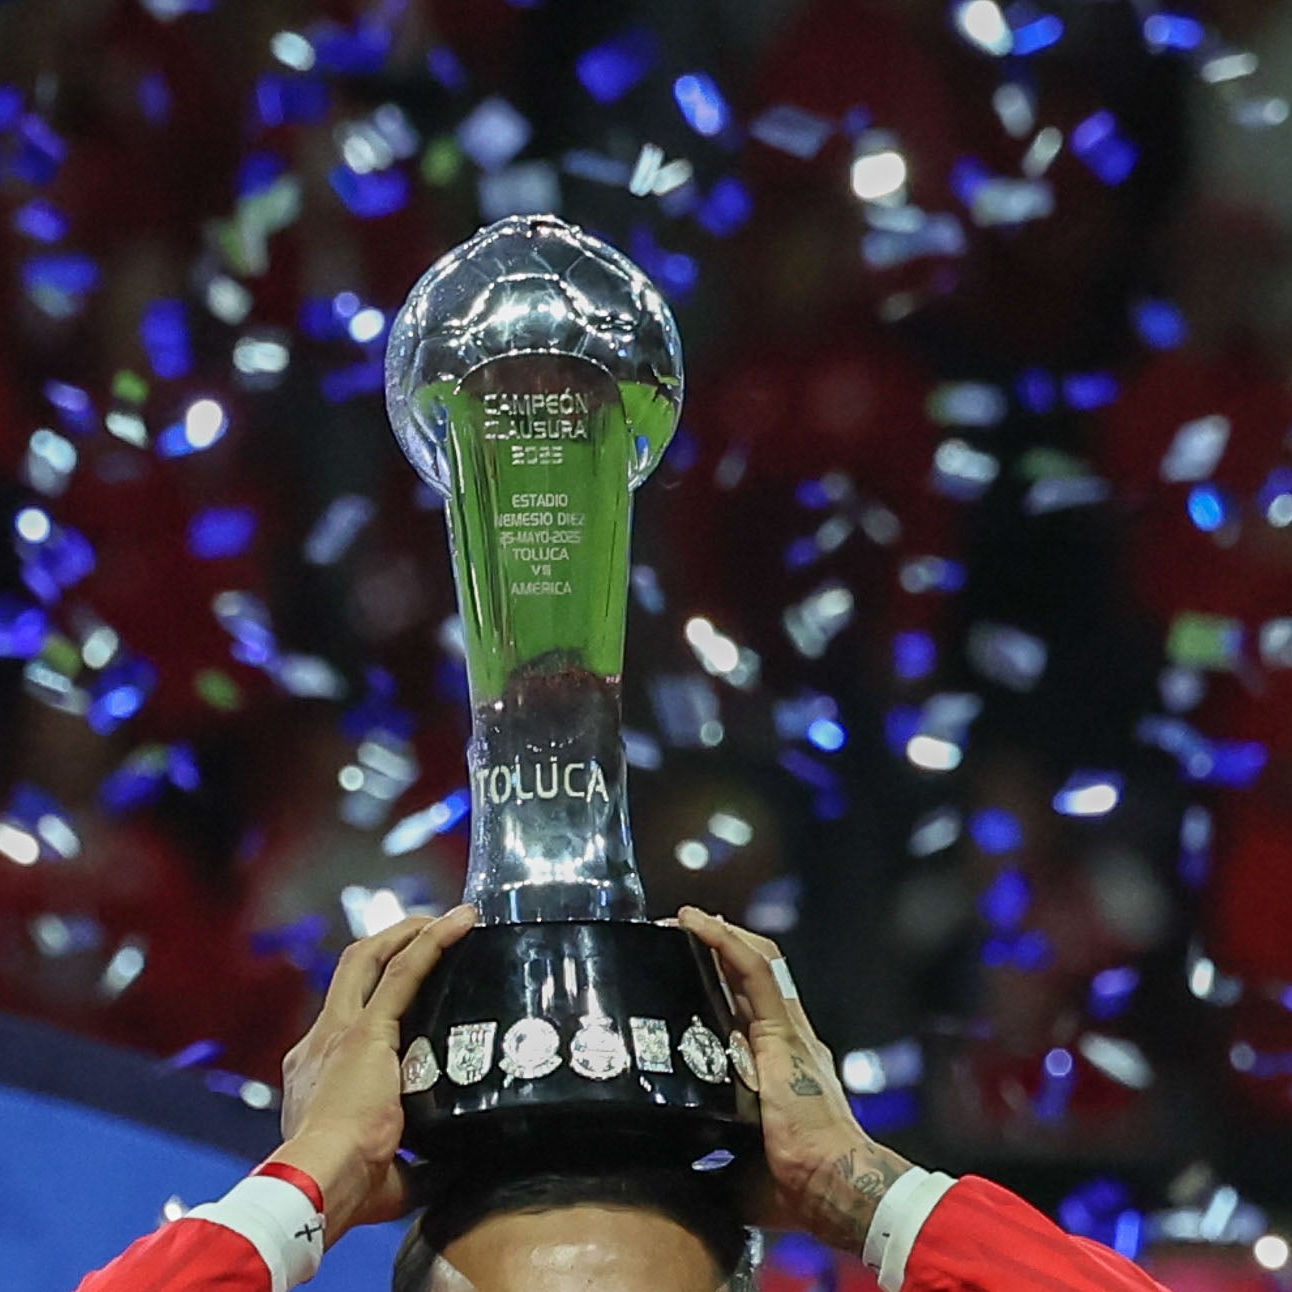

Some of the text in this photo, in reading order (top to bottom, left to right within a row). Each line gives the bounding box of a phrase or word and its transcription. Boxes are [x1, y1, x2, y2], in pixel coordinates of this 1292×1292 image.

[512, 493, 568, 508] ESTADIO
[495, 512, 553, 527] NEMESIO
[512, 547, 570, 561] TOLUCA
[475, 762, 610, 804] TOLUCA
